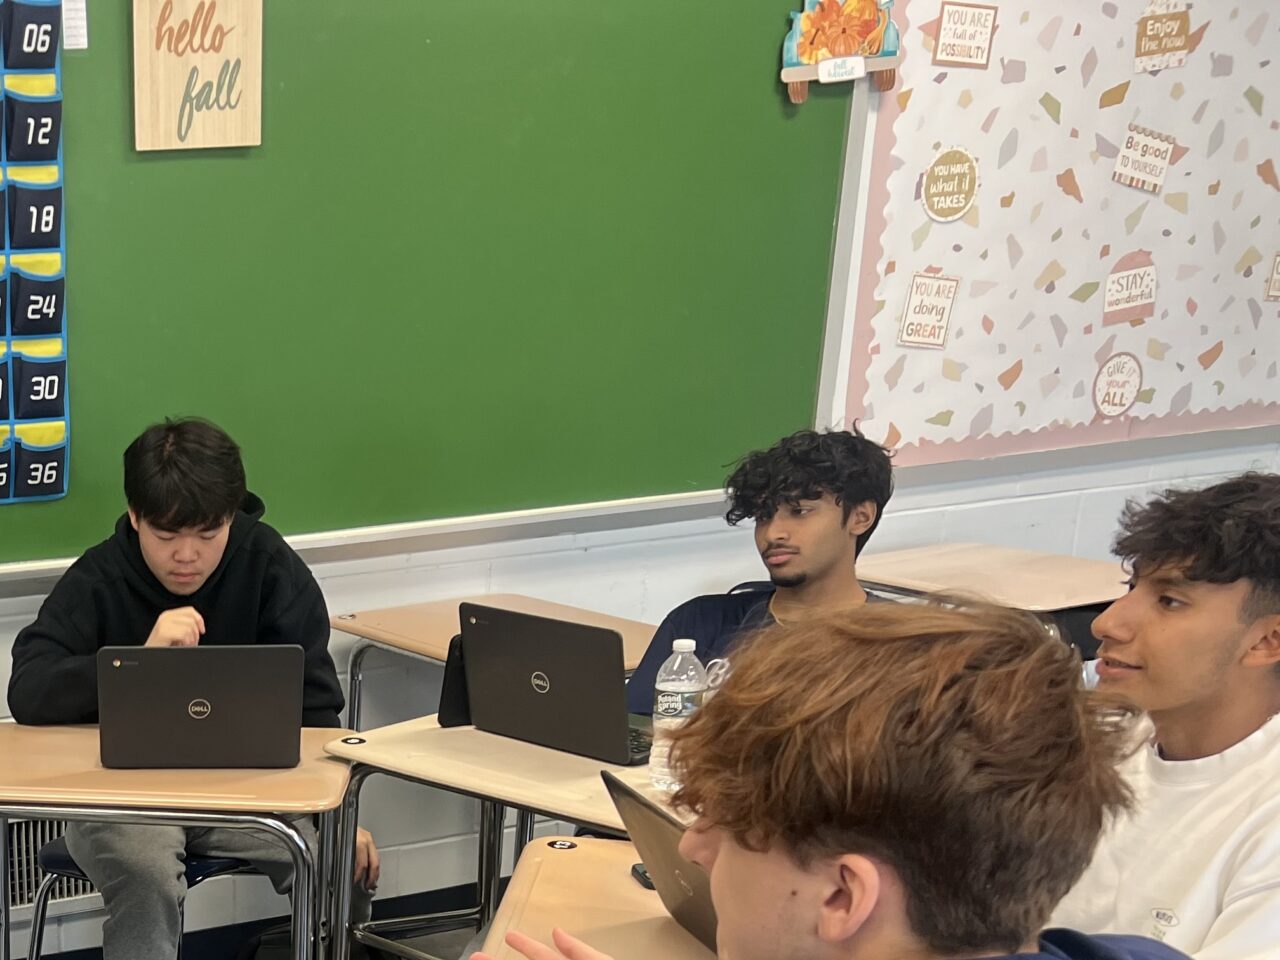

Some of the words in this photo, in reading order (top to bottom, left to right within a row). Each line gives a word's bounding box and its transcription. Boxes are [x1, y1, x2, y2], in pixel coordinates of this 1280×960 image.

[948, 9, 967, 25] YOU
[970, 12, 991, 28] ARE
[1147, 19, 1180, 37] Enjoy
[23, 24, 51, 52] 06
[155, 0, 236, 57] hello
[953, 27, 967, 40] full
[969, 30, 977, 40] of
[941, 43, 985, 59] POSSIBILITY
[1142, 37, 1159, 52] the
[1161, 35, 1185, 49] now
[177, 58, 242, 142] fall
[28, 118, 52, 144] 12
[1126, 136, 1139, 151] Be
[1141, 144, 1169, 160] good
[934, 165, 949, 175] YOU
[950, 162, 970, 174] HAVE
[1121, 155, 1130, 167] TO
[1131, 159, 1164, 177] YOURSELF
[930, 176, 959, 193] what
[962, 175, 969, 191] it
[933, 194, 965, 209] TAKES
[30, 206, 54, 232] 18
[915, 282, 933, 296] YOU
[935, 284, 954, 299] ARE
[1116, 271, 1147, 293] STAY
[28, 295, 55, 318] 24
[1107, 288, 1152, 307] wonderful
[913, 299, 945, 322] doing
[906, 322, 944, 340] GREAT
[1107, 361, 1127, 377] GIVE
[1126, 367, 1136, 378] IT
[30, 376, 58, 400] 30
[1101, 392, 1126, 406] ALL
[28, 462, 57, 484] 36
